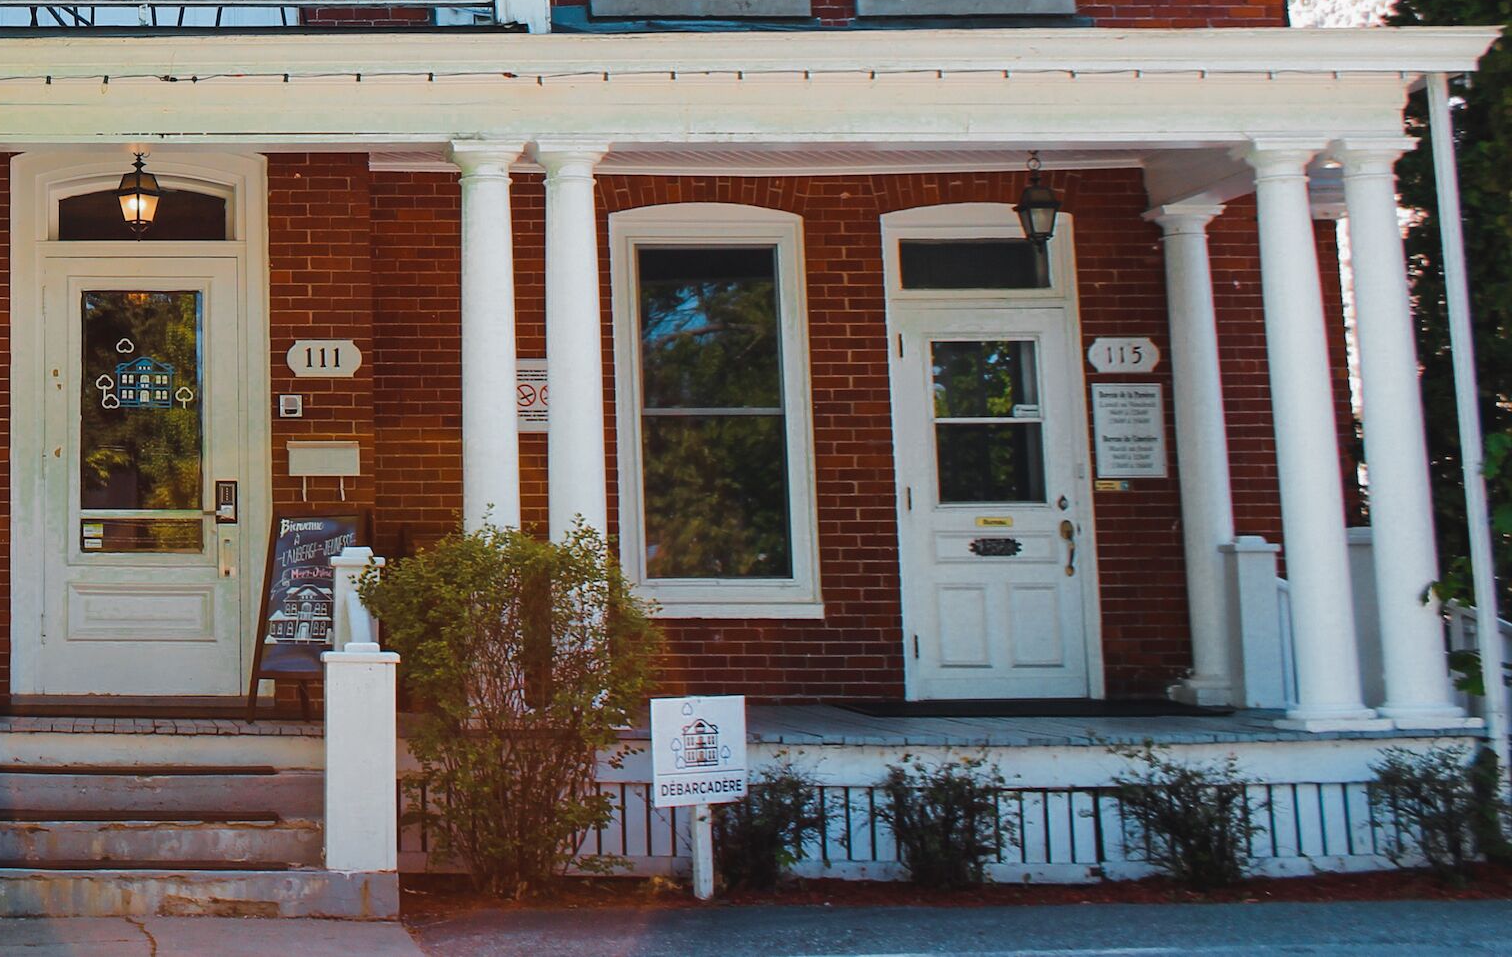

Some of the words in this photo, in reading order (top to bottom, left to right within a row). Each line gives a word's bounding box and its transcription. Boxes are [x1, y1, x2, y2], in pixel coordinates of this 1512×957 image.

[305, 347, 342, 368] 111
[1106, 346, 1143, 365] 115
[660, 777, 743, 797] DÉBARCADÈRE
